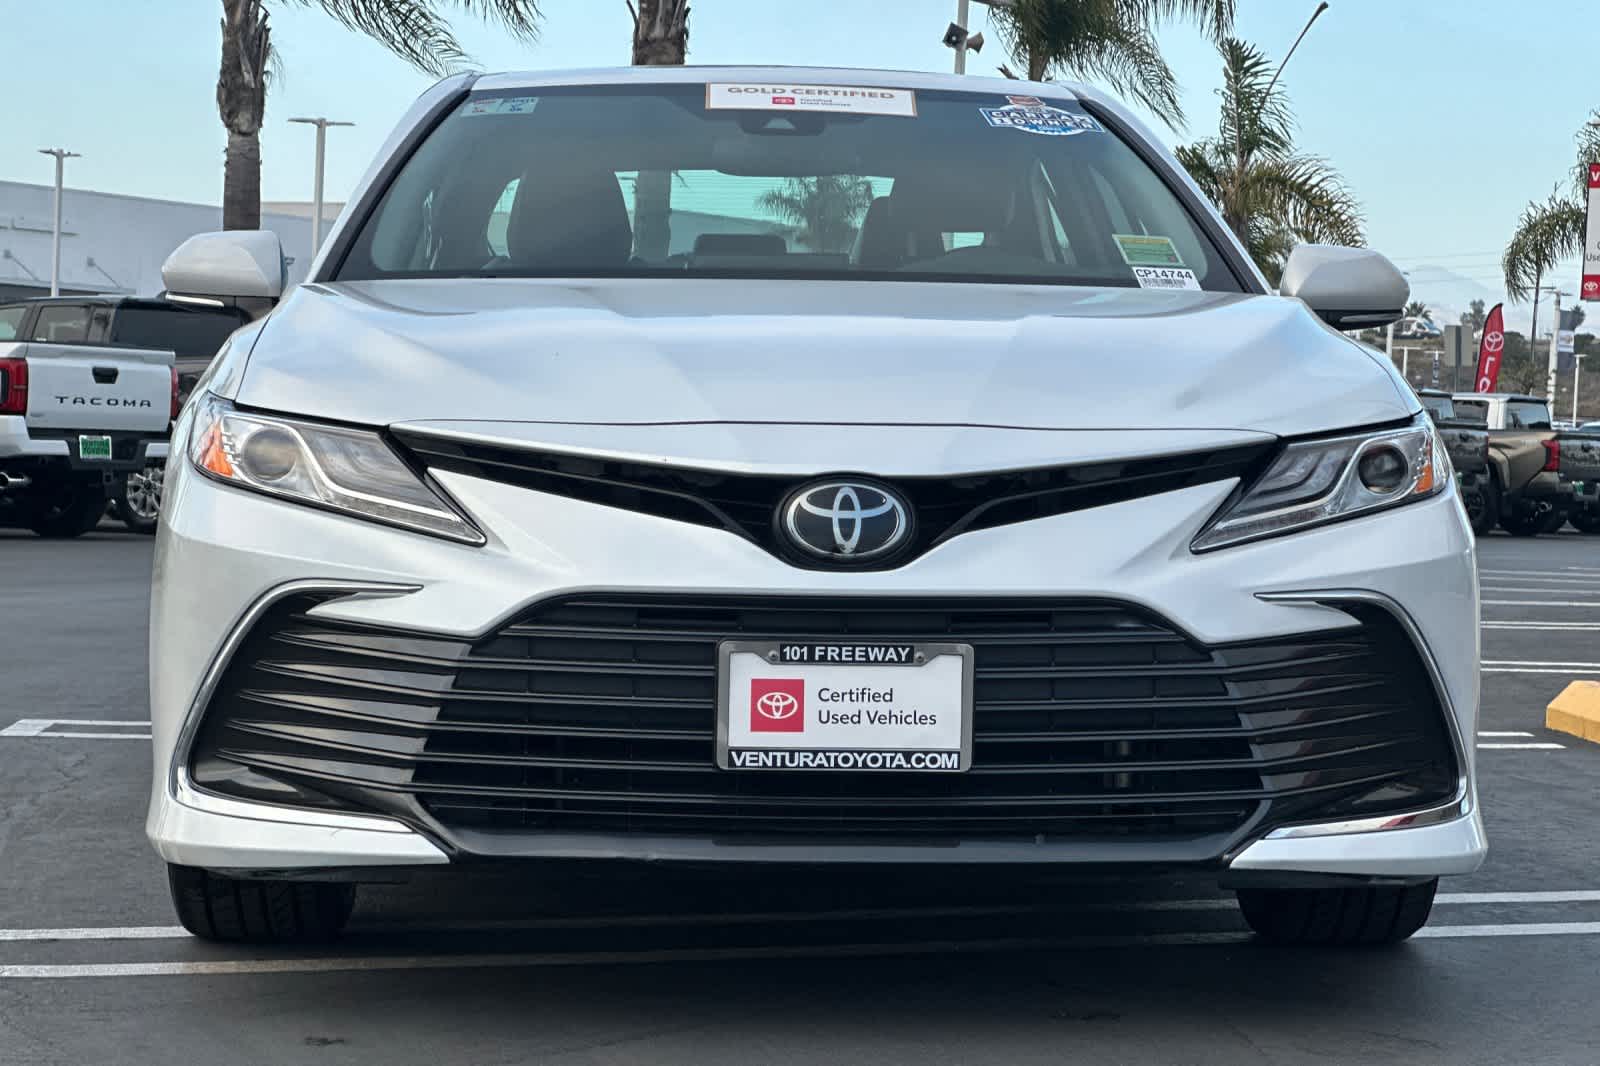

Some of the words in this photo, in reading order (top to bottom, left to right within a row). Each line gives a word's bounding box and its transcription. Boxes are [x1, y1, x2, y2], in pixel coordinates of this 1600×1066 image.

[727, 87, 786, 95] GOLD
[791, 88, 895, 99] CERTIFIED
[1135, 268, 1193, 280] CP14744
[55, 395, 152, 408] TACOMA
[783, 646, 808, 661] 101
[815, 646, 910, 662] FREEWAY
[818, 687, 893, 703] Certified
[818, 710, 861, 725] Used
[866, 710, 937, 725] Vehicles
[731, 751, 959, 769] VENTURATOYOTA.COM
